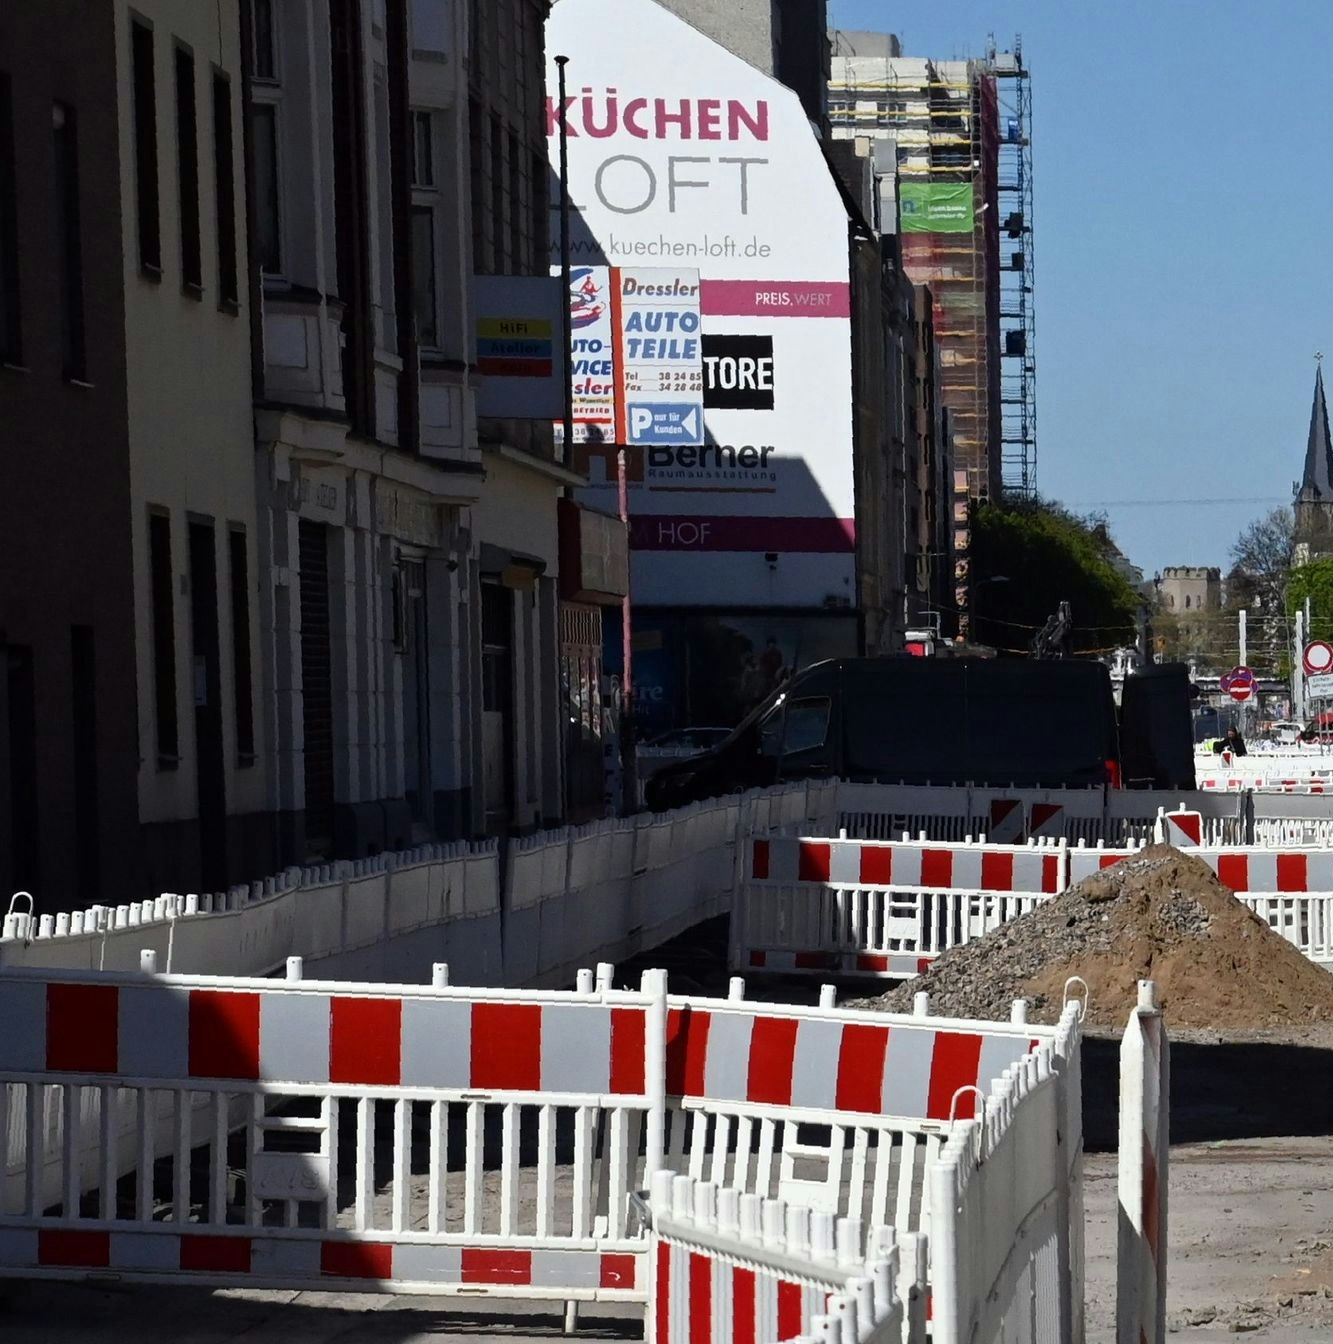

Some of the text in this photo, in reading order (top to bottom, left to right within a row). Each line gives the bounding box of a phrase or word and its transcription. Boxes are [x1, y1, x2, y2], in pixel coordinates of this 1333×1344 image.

[545, 87, 769, 141] KÜCHEN
[622, 277, 698, 297] Dressler
[755, 291, 833, 307] PREIS.WERT
[624, 311, 699, 333] AUTO
[627, 338, 697, 360] TEILE
[625, 372, 701, 381] Tel 38 24 85
[625, 383, 642, 392] Fax
[658, 383, 671, 391] 34
[673, 383, 686, 392] 28
[669, 412, 681, 422] für
[654, 425, 682, 435] Kunden
[649, 443, 775, 468] Berner
[649, 469, 777, 481] Raumausstattung
[658, 522, 713, 544] HOF
